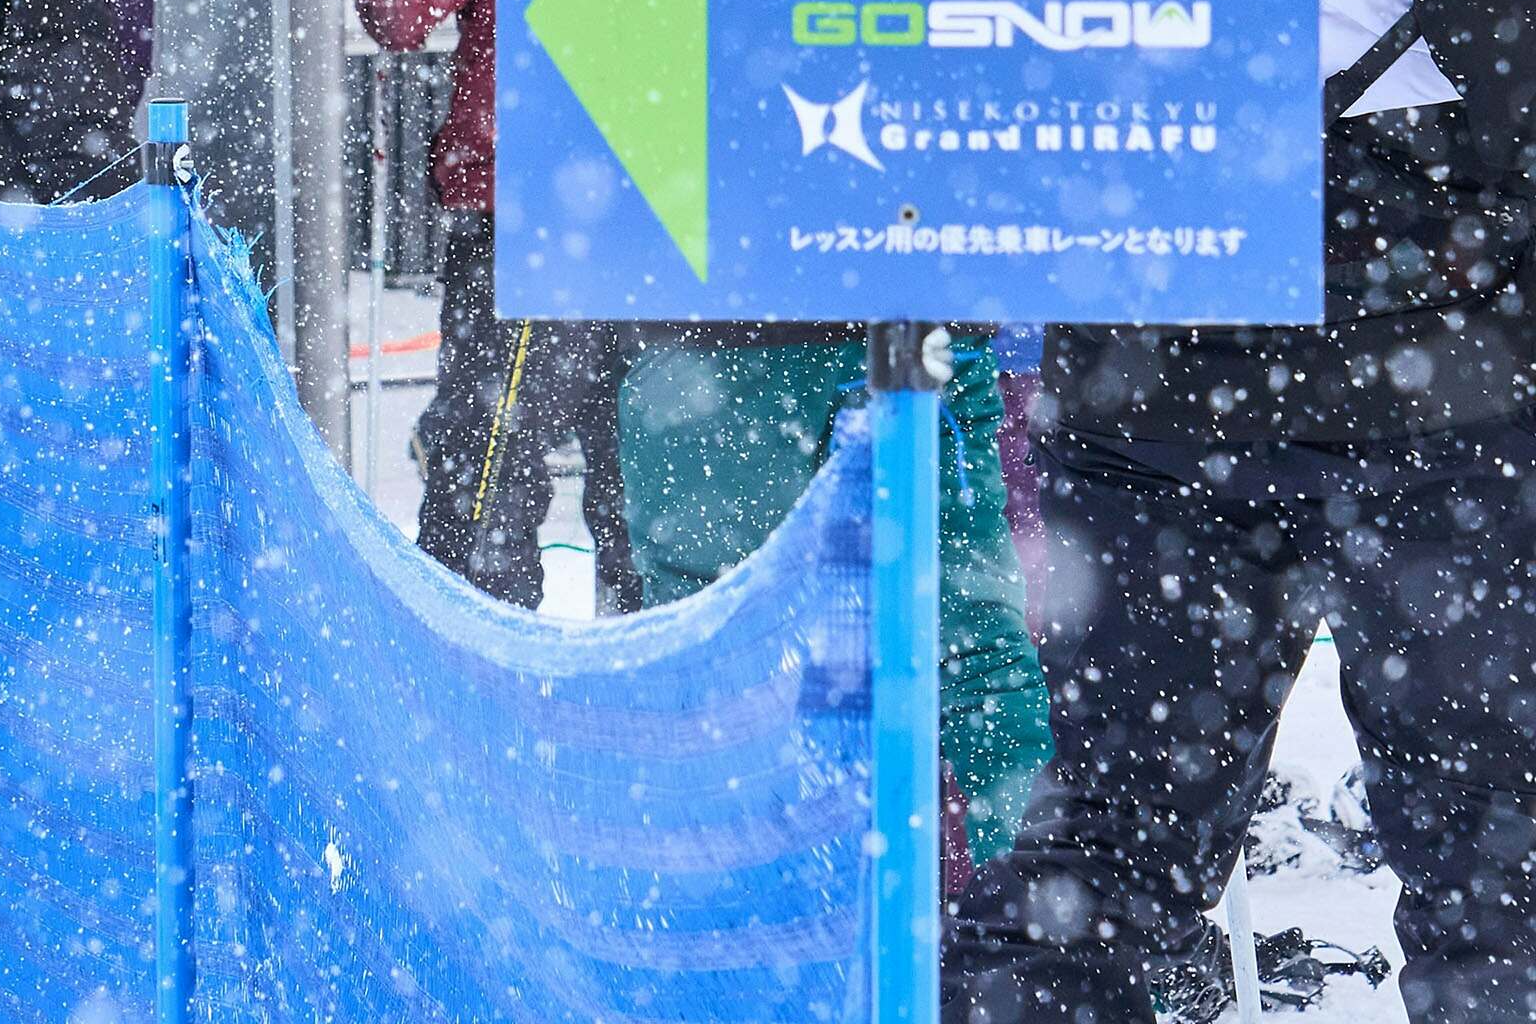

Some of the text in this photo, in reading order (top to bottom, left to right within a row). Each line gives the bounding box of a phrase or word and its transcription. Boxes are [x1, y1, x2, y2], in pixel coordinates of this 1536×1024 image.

[792, 1, 1212, 51] GOSNOW
[880, 100, 1217, 122] NISEKO TOKYU
[880, 123, 1218, 153] Grand HIRAFU
